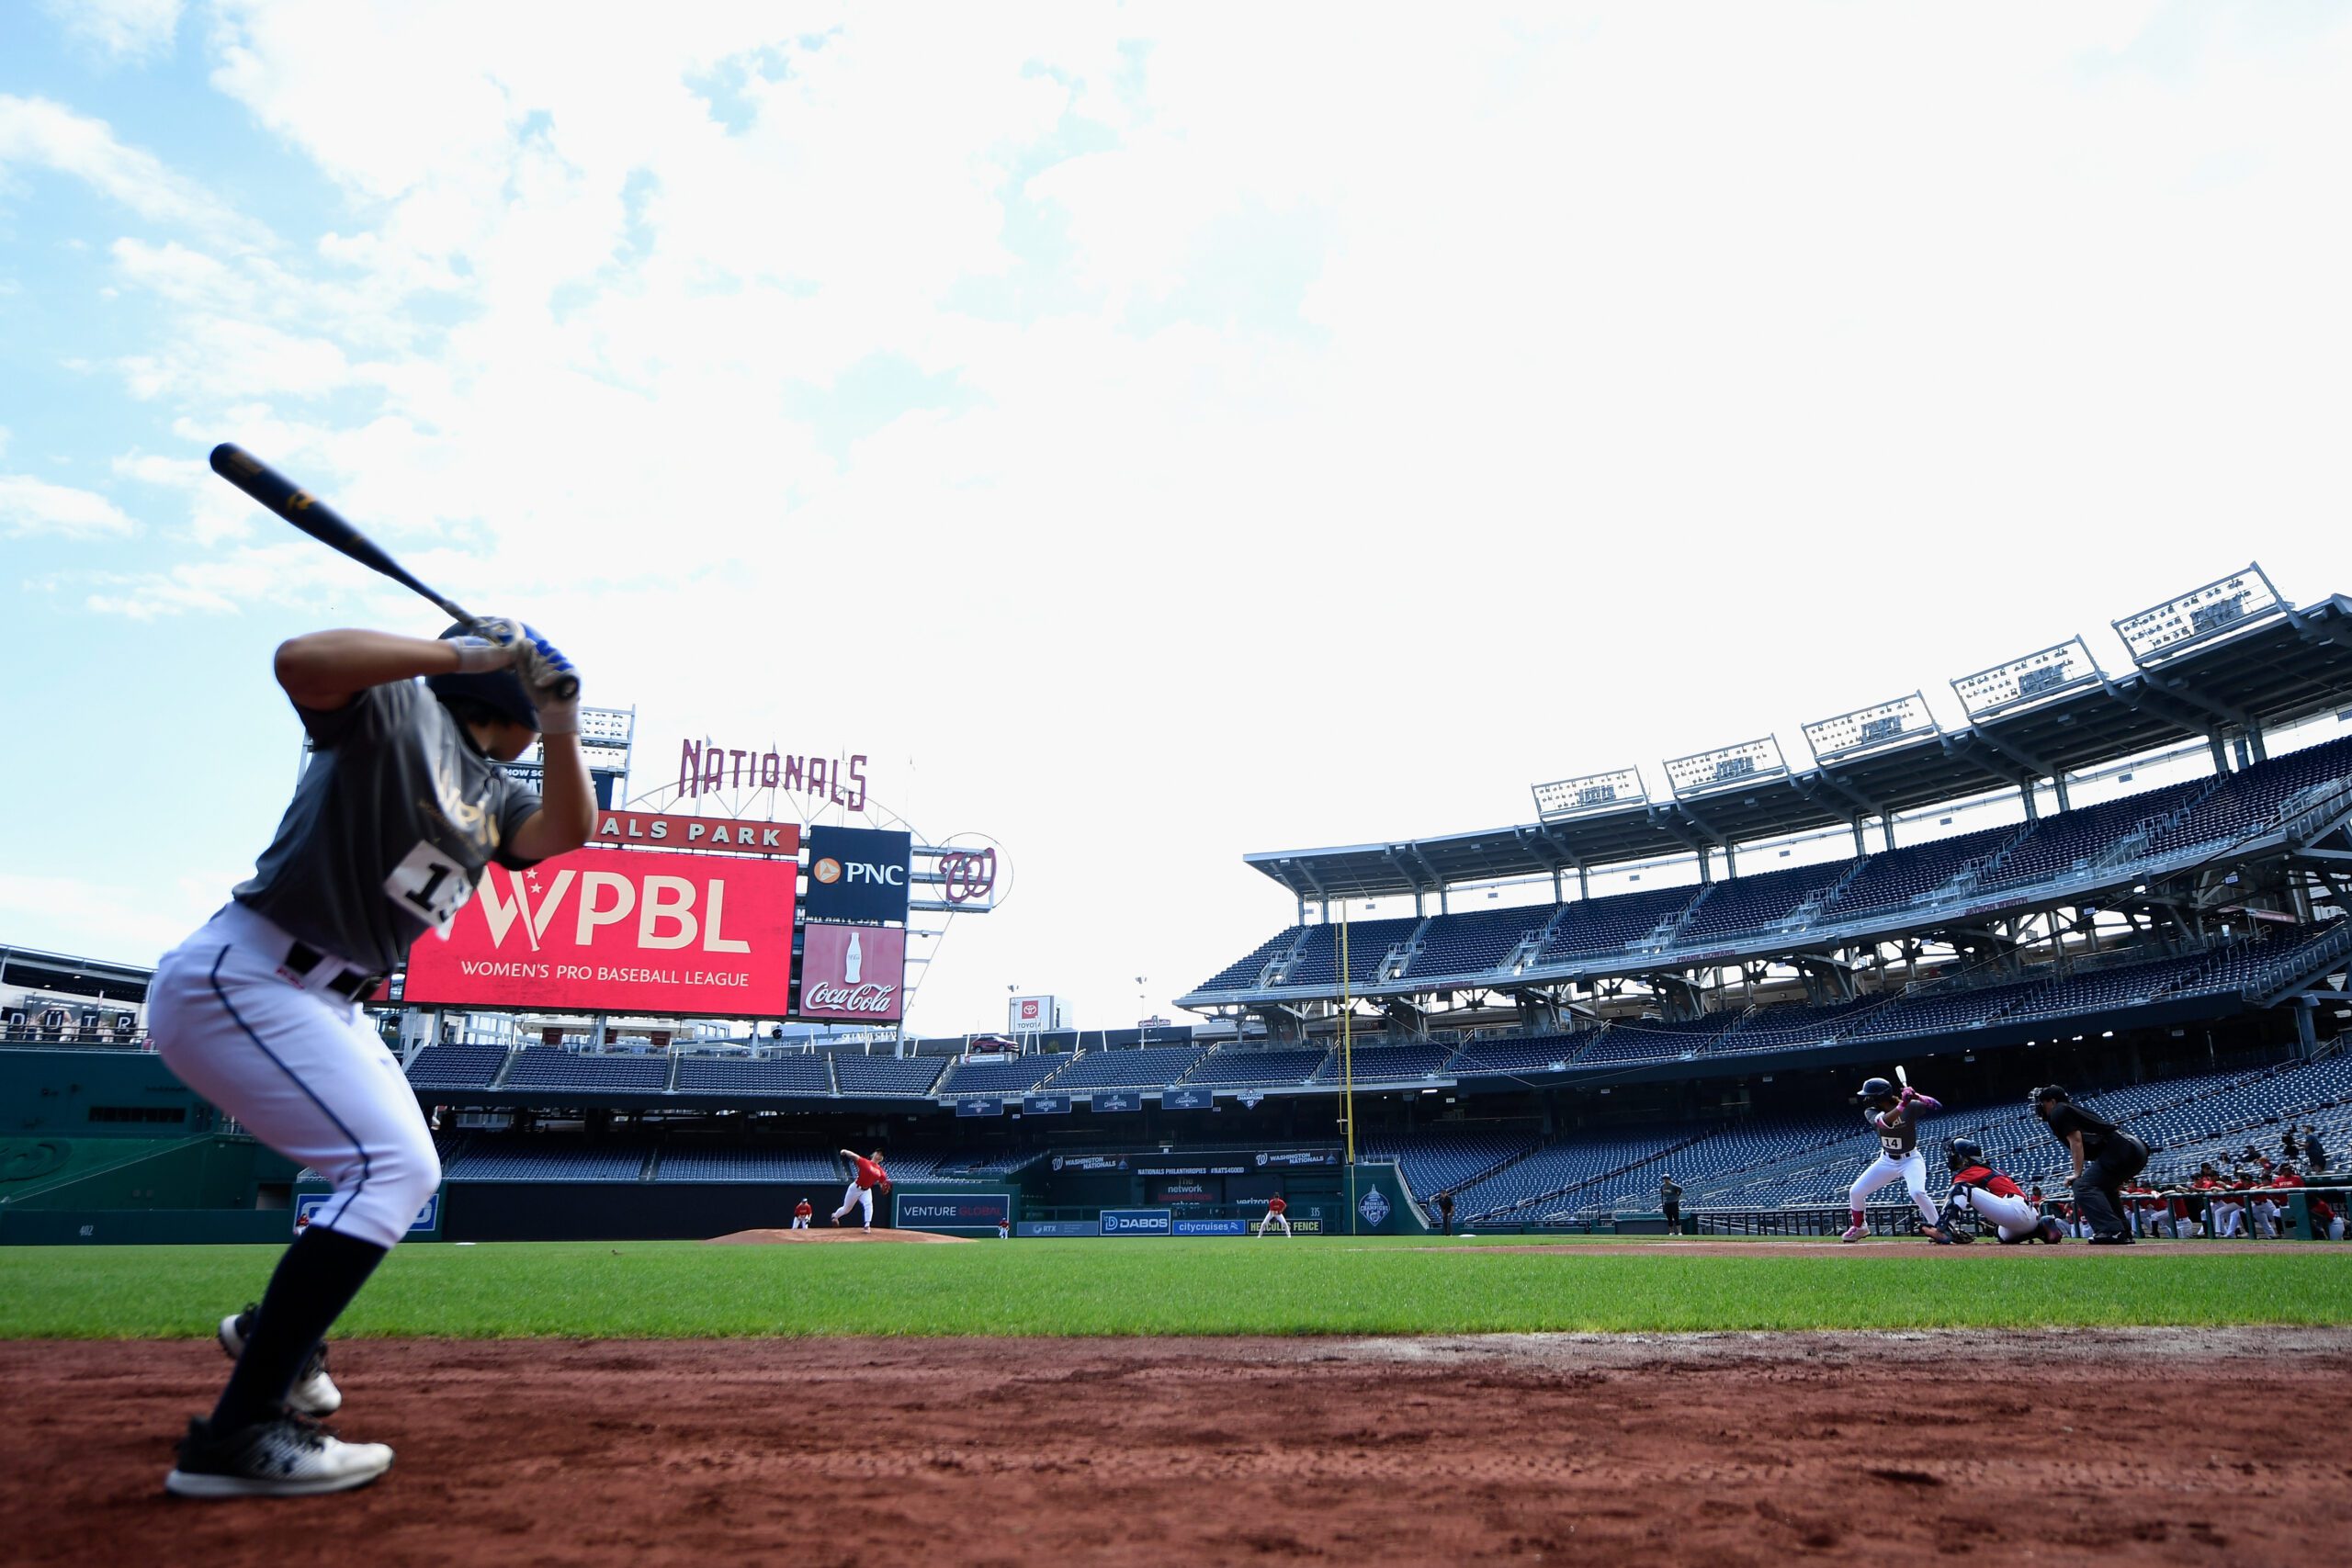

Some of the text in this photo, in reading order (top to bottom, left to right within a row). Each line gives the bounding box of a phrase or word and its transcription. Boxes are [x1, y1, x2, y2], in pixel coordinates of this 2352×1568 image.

[678, 739, 867, 812] NATIONALS
[688, 823, 781, 847] PARK
[844, 862, 904, 886] PNC
[476, 864, 751, 953] WPBL
[461, 961, 750, 987] WOMEN'S PRO BASEBALL LEAGUE
[805, 982, 897, 1012] Coca-Cola
[1885, 1139, 1898, 1147] 14
[1065, 1156, 1103, 1166] WASHINGTON
[1270, 1153, 1310, 1162] WASHINGTON
[1289, 1156, 1324, 1164] NATIONALS
[1083, 1161, 1116, 1169] NATIONALS
[1168, 1183, 1203, 1193] network
[904, 1206, 1001, 1216] VENTURE GLOBAL
[1310, 1207, 1320, 1216] 335
[1119, 1219, 1168, 1228] DABOS
[1179, 1222, 1228, 1233] citycruises
[1293, 1221, 1318, 1231] FENCE
[80, 1224, 93, 1236] 402
